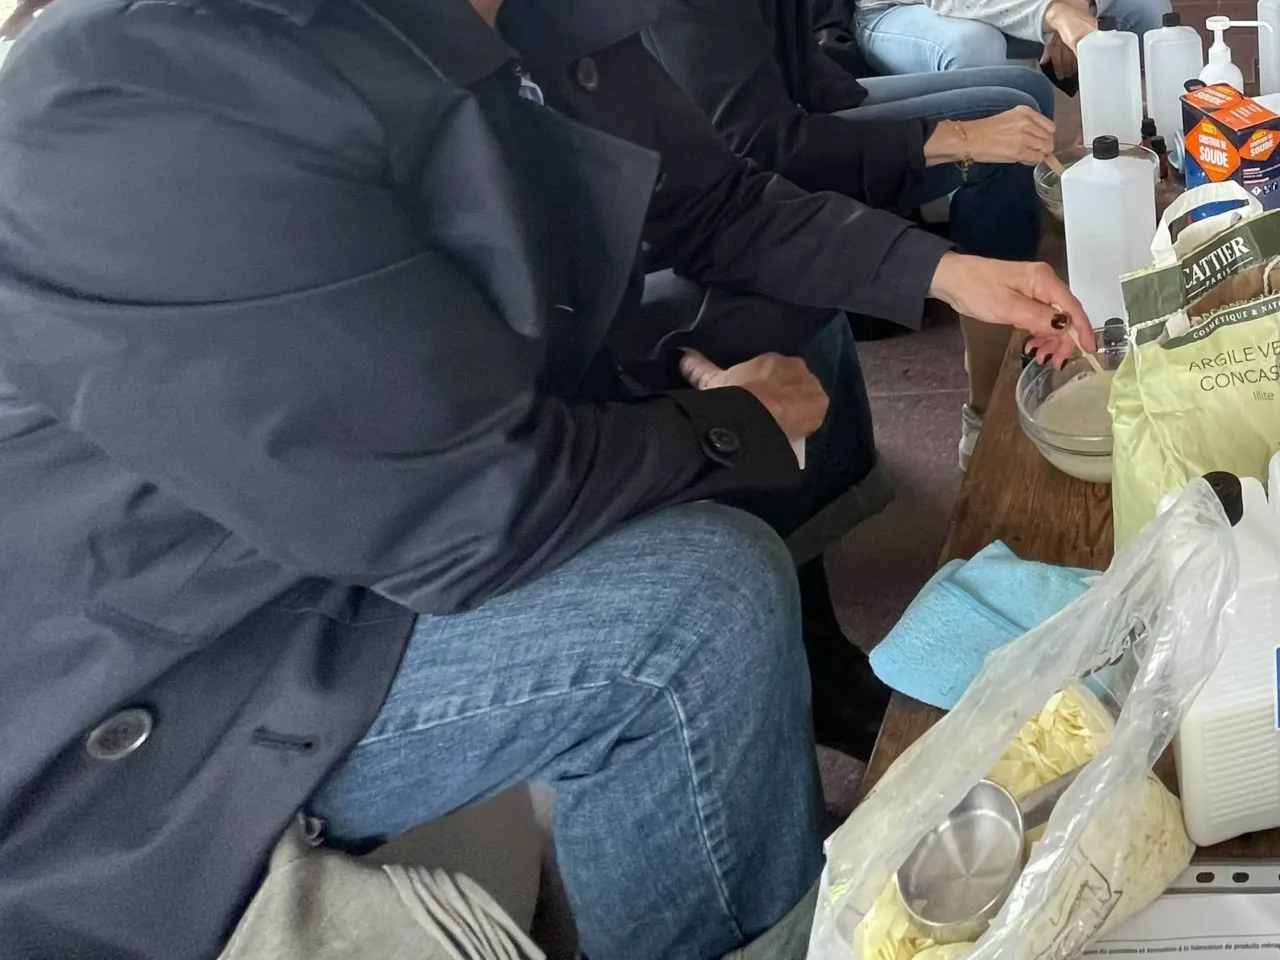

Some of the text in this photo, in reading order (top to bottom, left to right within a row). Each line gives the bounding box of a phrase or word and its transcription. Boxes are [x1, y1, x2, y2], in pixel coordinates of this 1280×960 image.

[1199, 145, 1230, 168] SOUDE
[1249, 138, 1275, 157] SOUDE
[1183, 236, 1250, 289] CATTIER
[1205, 267, 1232, 288] PARIS
[1193, 310, 1249, 339] COSMÉTIQUE
[1251, 307, 1259, 316] &
[1188, 346, 1254, 372] ARGILE
